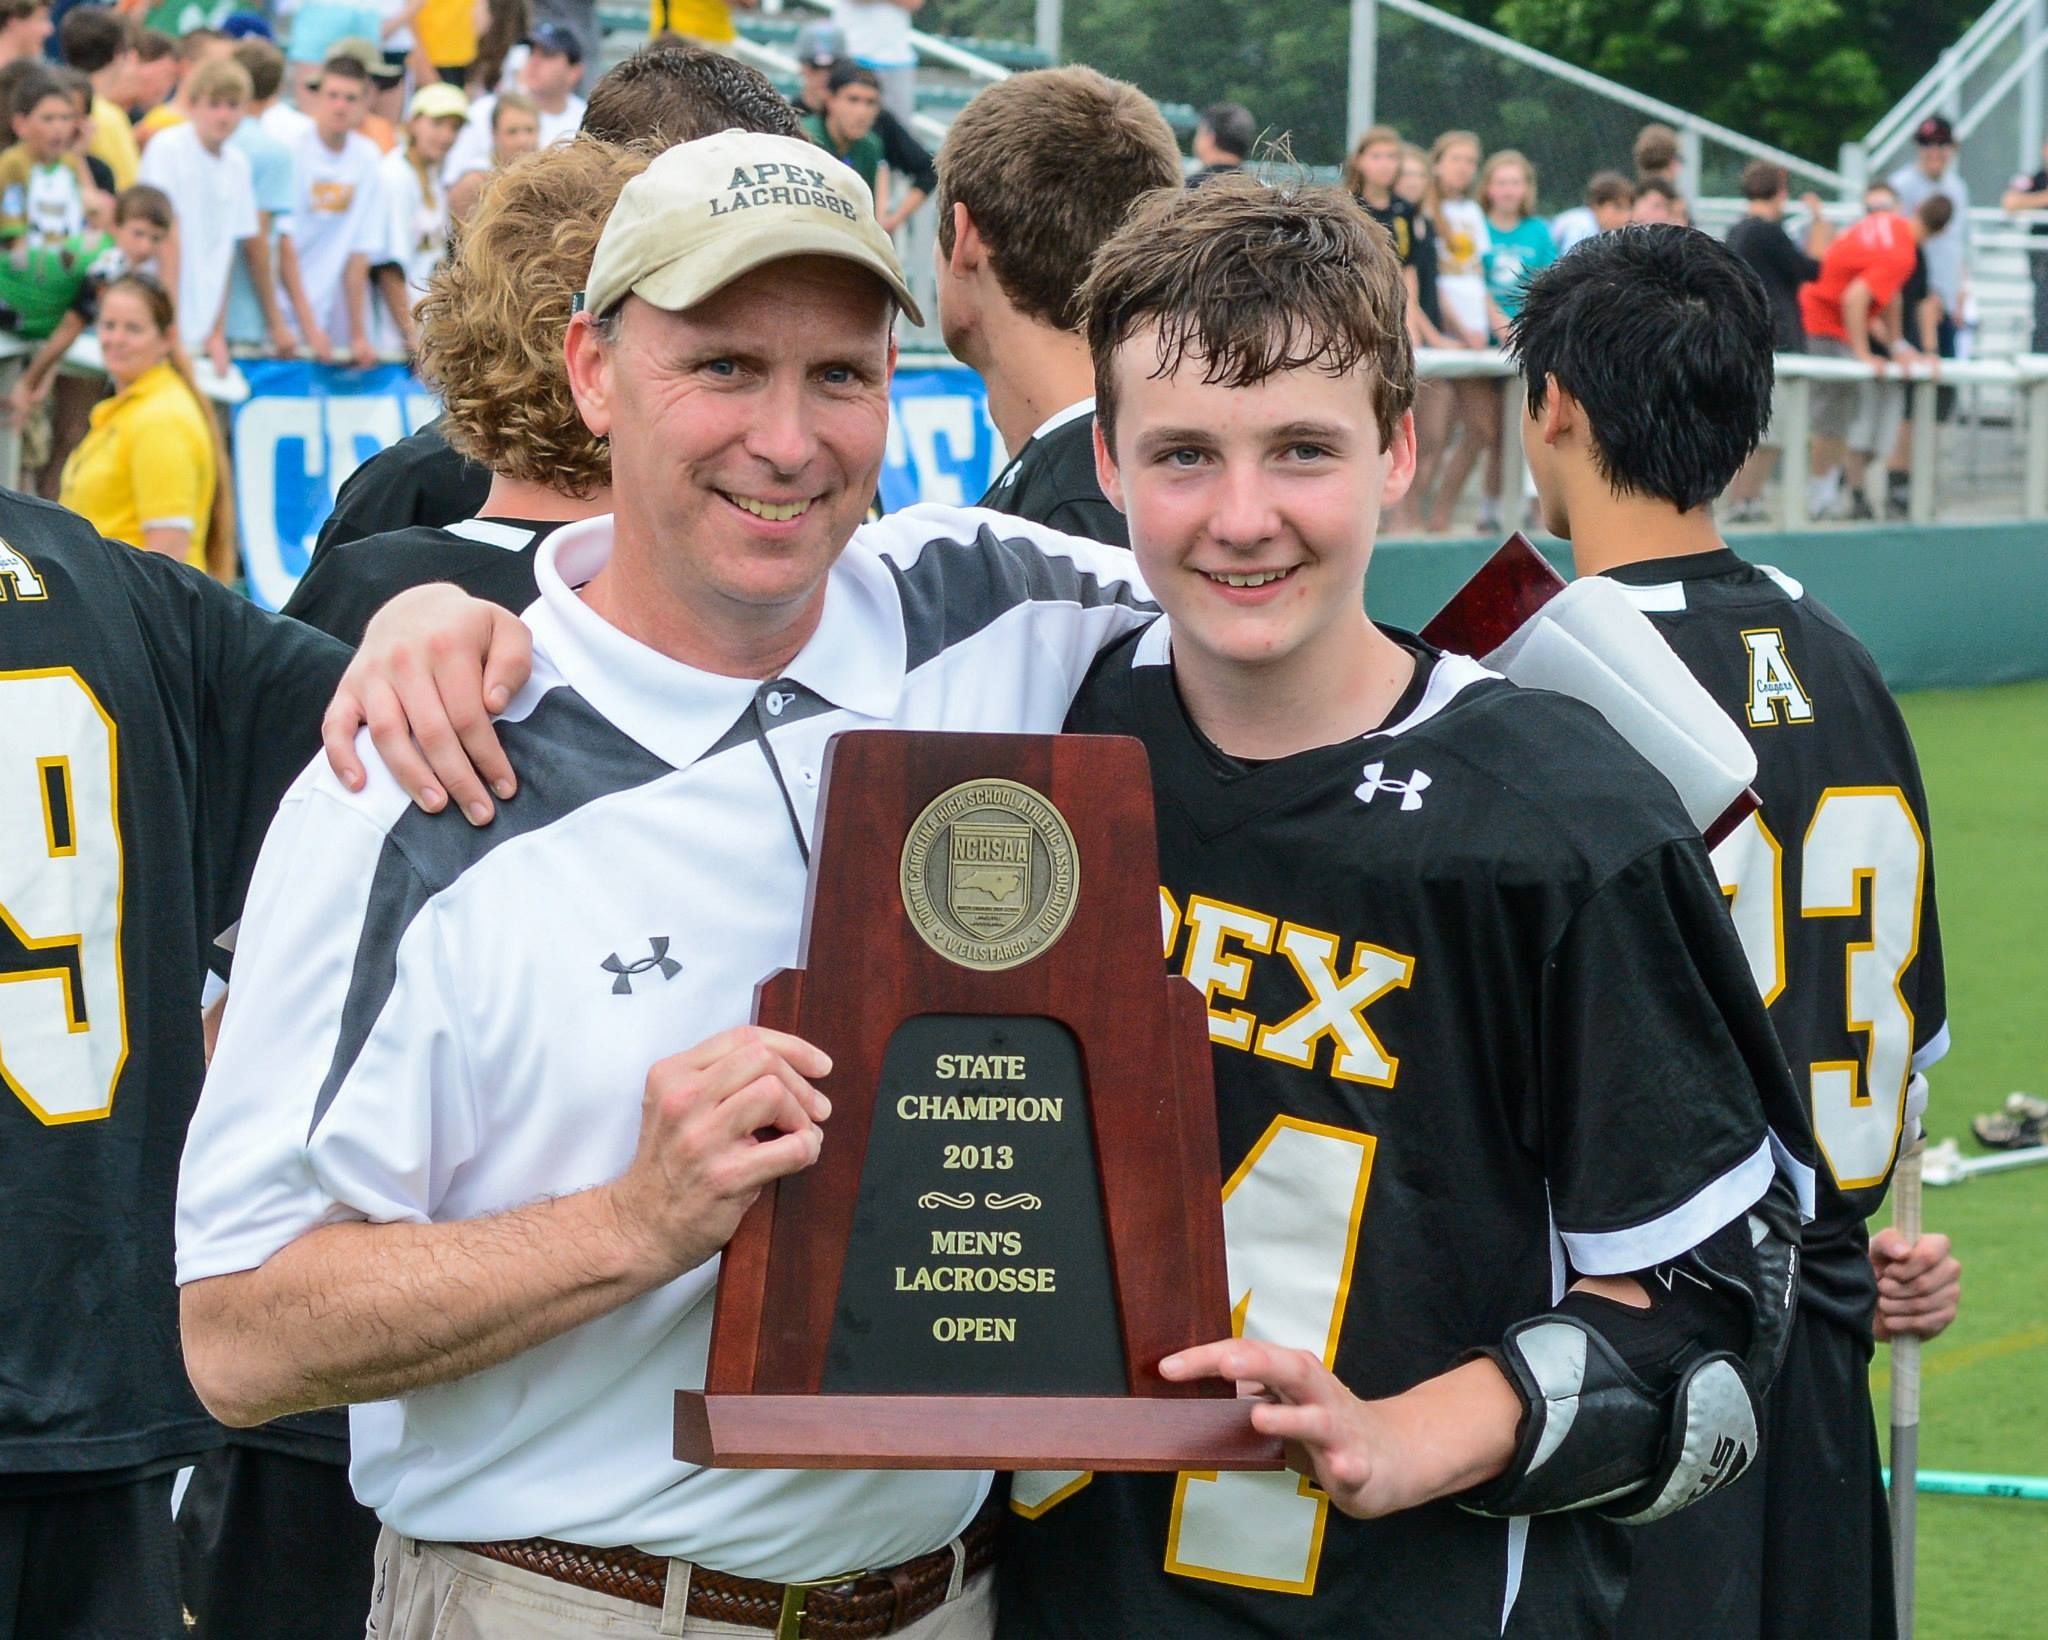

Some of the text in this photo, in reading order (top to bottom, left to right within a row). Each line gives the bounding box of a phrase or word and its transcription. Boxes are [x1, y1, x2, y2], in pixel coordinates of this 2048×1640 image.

[727, 163, 835, 192] APEX
[709, 187, 857, 221] LACROSSE
[1740, 627, 1815, 727] A
[1757, 679, 1793, 694] Cougars
[908, 789, 1070, 934] NORTH CAROLINA HIGH SCHOOL ATHLETIC ASSOCIATION
[954, 836, 1028, 862] NCHSAA
[946, 936, 1029, 961] WELLS FARGO
[1159, 885, 1416, 1089] EX
[935, 1055, 1026, 1080] STATE
[896, 1095, 1063, 1122] CHAMPION
[943, 1145, 1014, 1170] 2013
[931, 1231, 1022, 1256] MEN'S
[895, 1267, 1056, 1293] LACROSSE
[932, 1317, 1017, 1342] OPEN
